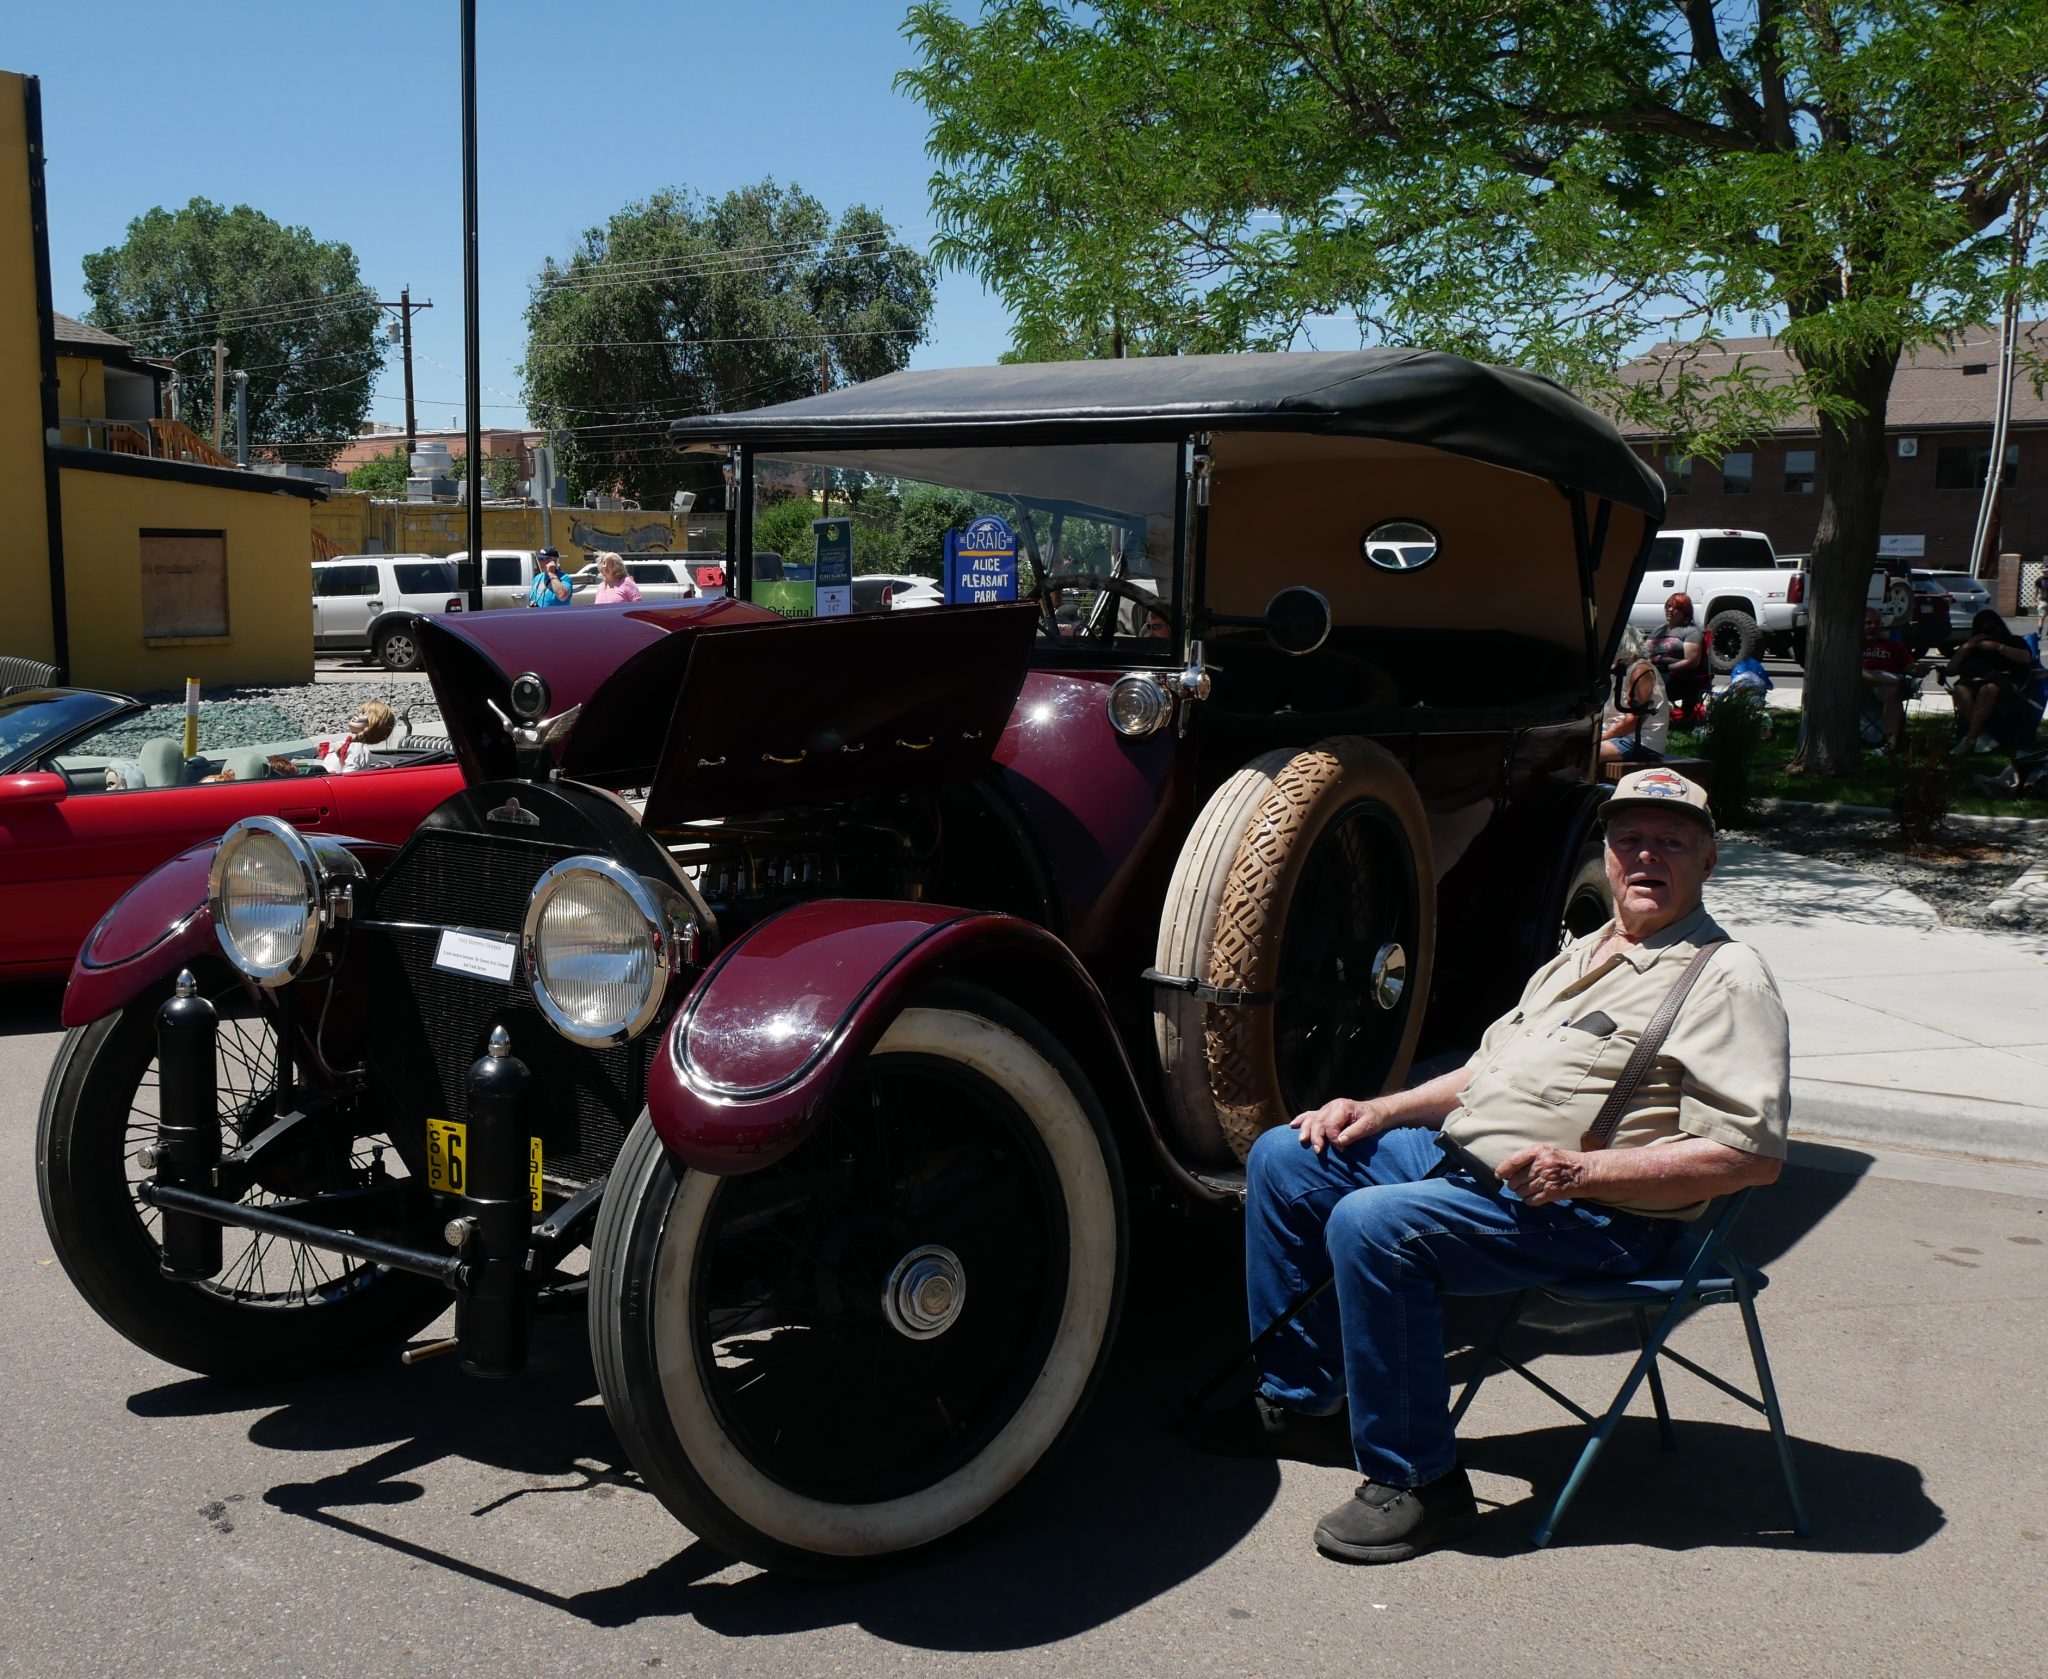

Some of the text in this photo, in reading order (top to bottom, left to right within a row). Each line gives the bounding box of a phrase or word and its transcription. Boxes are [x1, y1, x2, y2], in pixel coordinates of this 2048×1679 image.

[966, 531, 1007, 550] CRAIG
[972, 558, 1000, 572] ALICE
[961, 573, 1009, 588] PLEASANT
[974, 590, 998, 603] PARK
[827, 604, 840, 613] 147
[430, 1130, 442, 1180] COLO
